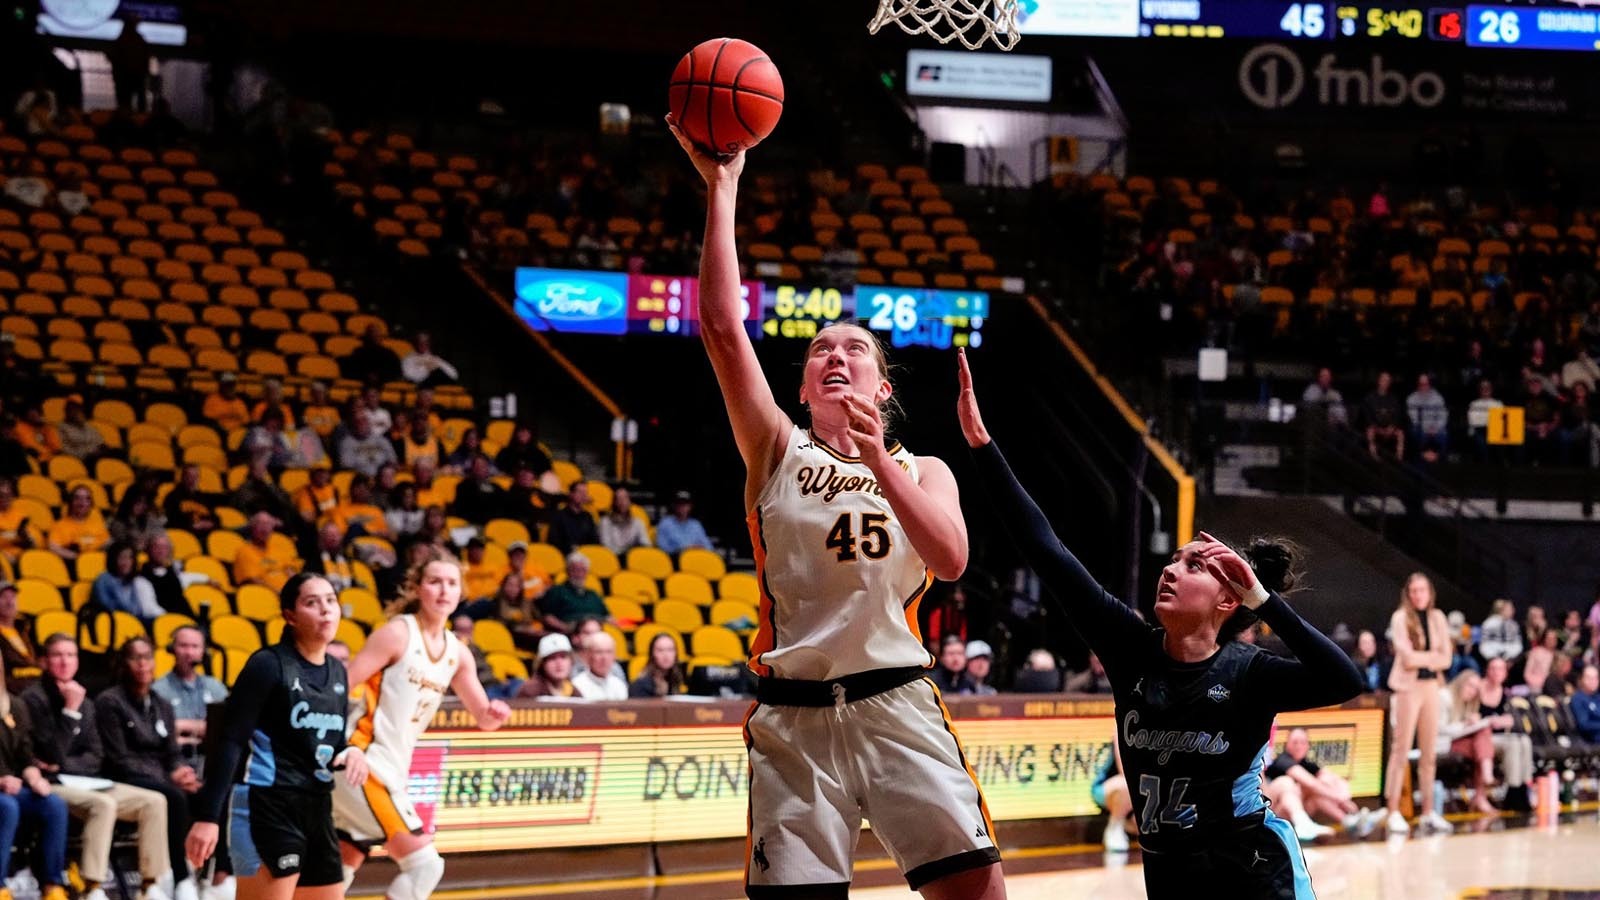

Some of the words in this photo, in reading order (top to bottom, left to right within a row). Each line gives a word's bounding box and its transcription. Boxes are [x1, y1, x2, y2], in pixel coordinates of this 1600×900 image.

[1279, 3, 1325, 37] 45
[1367, 9, 1421, 37] 5:40
[1478, 11, 1520, 43] 26
[1313, 52, 1446, 107] fnbo
[538, 282, 602, 316] Ford
[775, 286, 842, 320] 5:40
[868, 293, 917, 331] 26
[797, 464, 886, 503] Wyom
[825, 512, 894, 562] 45
[1124, 710, 1230, 765] Cougars
[643, 755, 747, 801] DOIN
[963, 744, 1036, 783] HING
